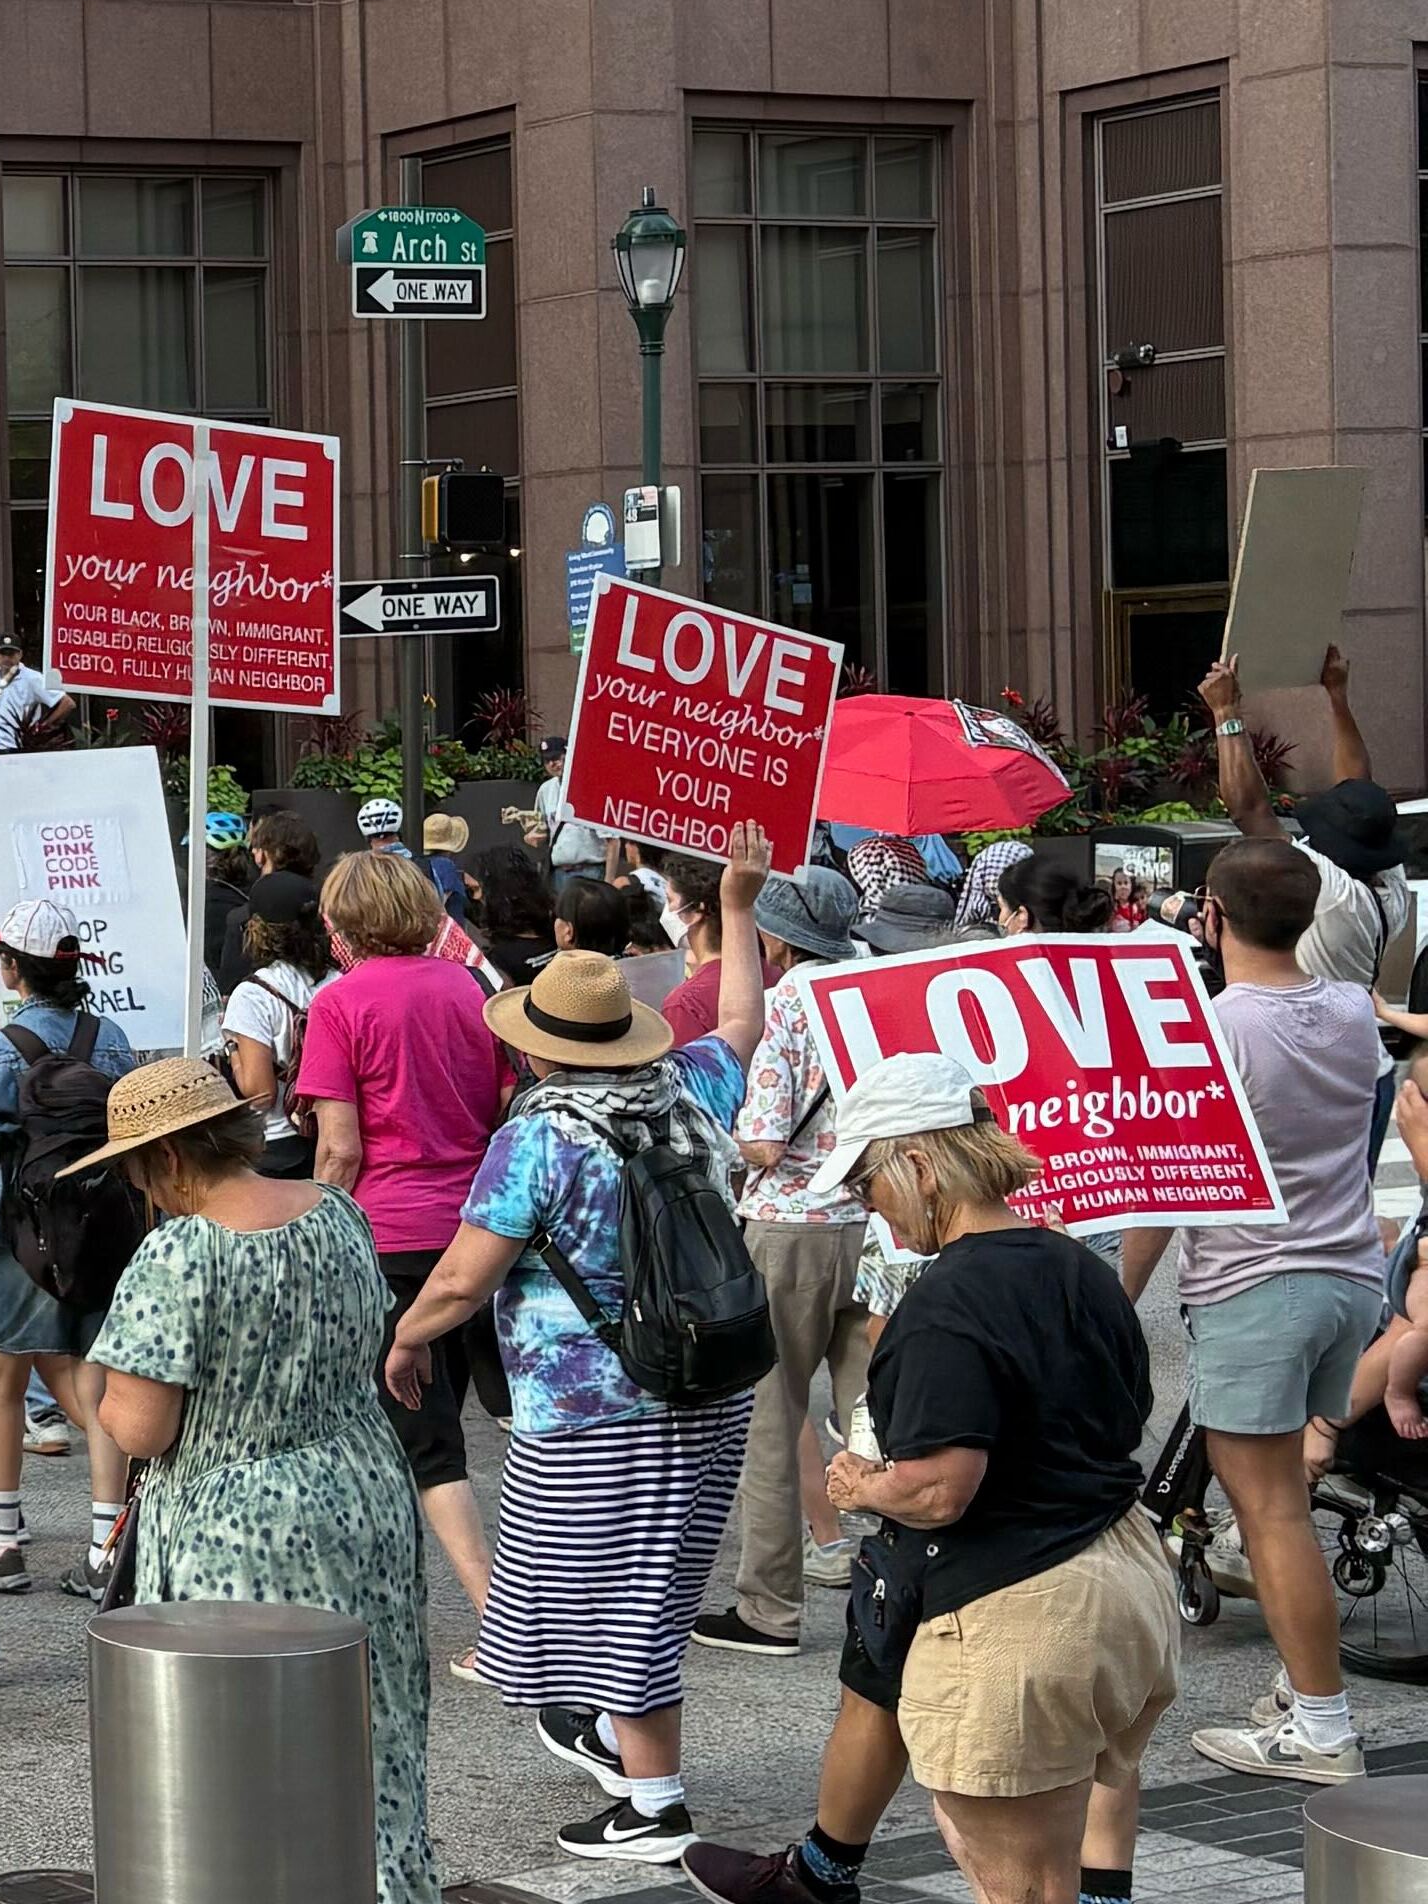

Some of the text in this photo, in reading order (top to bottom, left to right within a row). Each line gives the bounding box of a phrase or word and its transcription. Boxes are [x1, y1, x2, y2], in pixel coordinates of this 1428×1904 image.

[388, 209, 450, 225] 1800 N 1700
[392, 231, 477, 262] Arch St
[396, 281, 467, 301] ONE WAY
[90, 433, 309, 542] LOVE
[59, 554, 147, 587] your
[382, 594, 479, 618] ONE WAY
[63, 601, 330, 647] YOUR BLACK, BRWN, IMMIGRANT,
[137, 636, 237, 662] RELIGIOSLY
[242, 645, 334, 672] DIFFERENT,
[616, 594, 813, 716] LOVE
[122, 659, 173, 683] FULLY
[175, 664, 234, 686] HUAN
[239, 672, 326, 694] NEIGHBOR
[587, 673, 667, 709] your
[607, 711, 789, 787] EVERYONE IS
[654, 766, 732, 814] YOUR
[40, 824, 95, 843] CODE
[603, 796, 734, 857] NEIGHBO
[42, 842, 96, 858] PINK
[45, 855, 100, 874] CODE
[47, 872, 103, 891] PINK
[1049, 1143, 1246, 1171] BROWN, IMMIGRANT,
[1152, 1163, 1254, 1182] DIFFERENT,
[1074, 1187, 1149, 1211] HUMAN
[1153, 1184, 1247, 1203] NEIGHBOR
